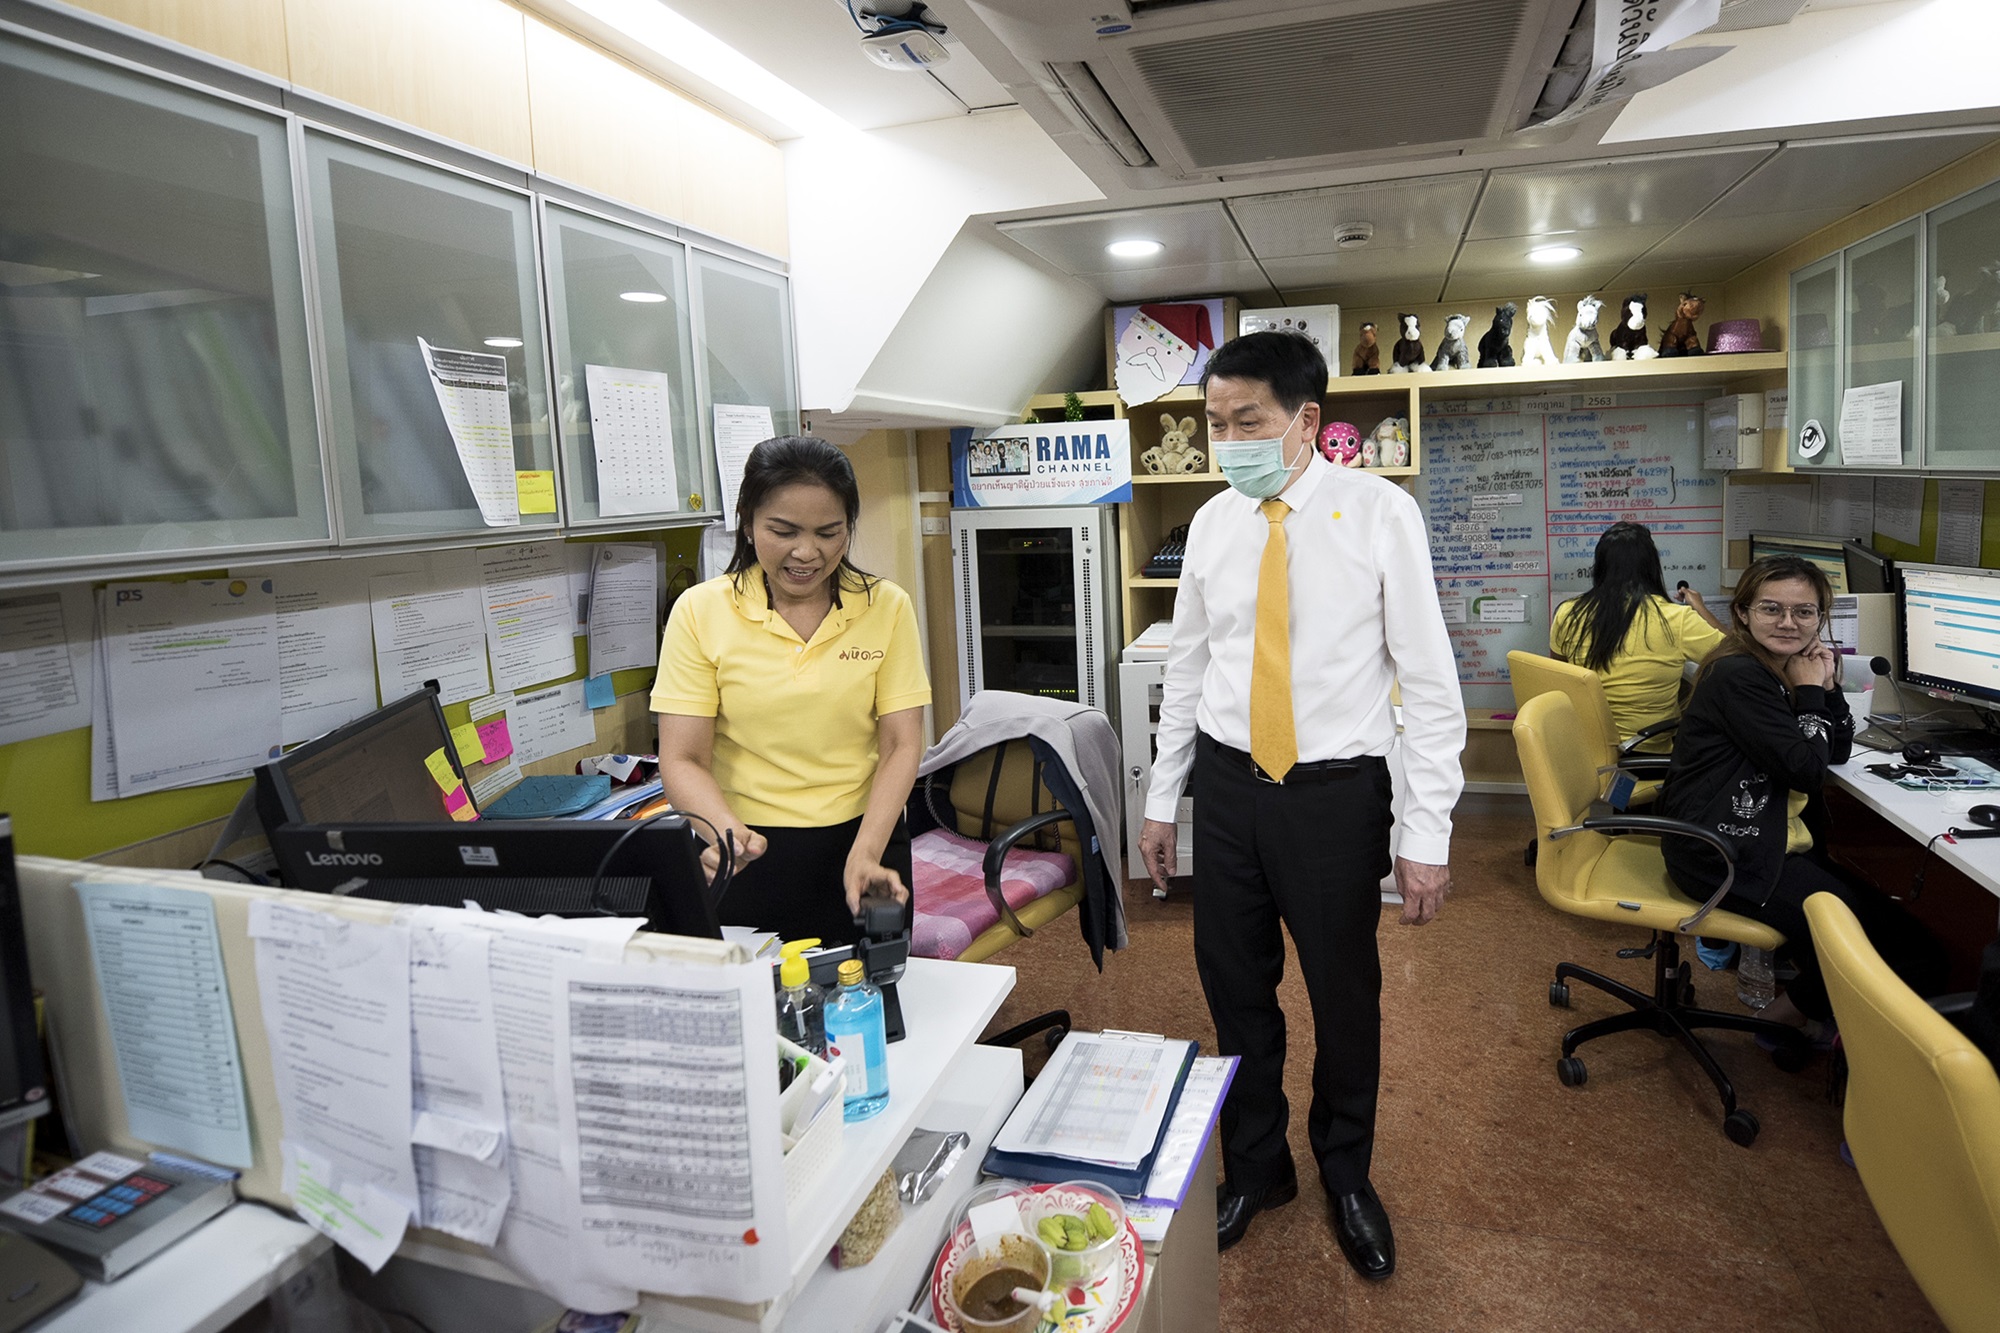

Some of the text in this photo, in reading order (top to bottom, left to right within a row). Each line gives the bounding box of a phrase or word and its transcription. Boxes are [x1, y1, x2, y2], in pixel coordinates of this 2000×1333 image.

[1588, 397, 1612, 406] 2563
[1036, 434, 1111, 462] RAMA
[1037, 463, 1112, 474] CHANNEL
[1470, 512, 1497, 521] 49085
[1454, 523, 1480, 532] 48976
[1558, 537, 1579, 549] CPR
[1513, 561, 1539, 570] 49087
[305, 850, 383, 866] Lenovo
